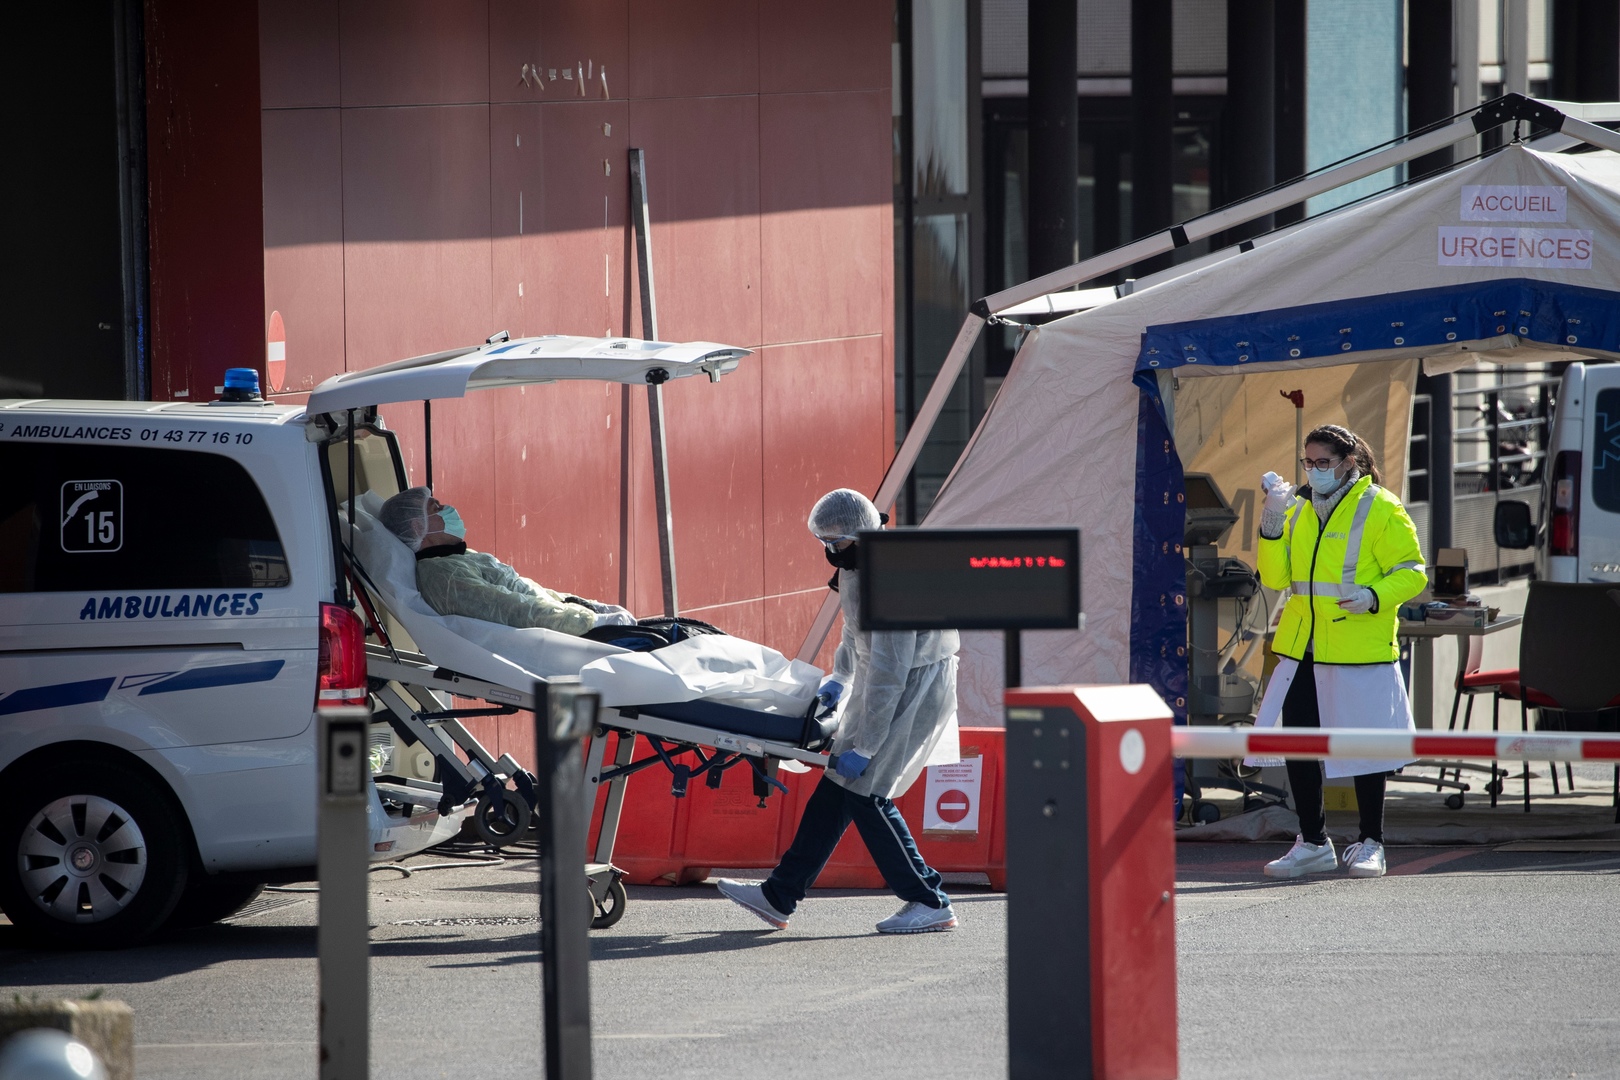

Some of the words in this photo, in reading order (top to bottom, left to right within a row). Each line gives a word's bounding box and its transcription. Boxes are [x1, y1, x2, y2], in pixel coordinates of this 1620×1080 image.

[1471, 195, 1557, 212] ACCUEIL
[1441, 236, 1591, 261] URGENCES
[11, 425, 132, 441] AMBULANCES
[140, 429, 158, 442] 01
[163, 430, 182, 442] 43
[188, 431, 207, 443] 77
[212, 432, 229, 444] 16
[235, 432, 253, 445] 10
[74, 483, 83, 491] EN
[83, 482, 111, 491] LIAISONS
[84, 511, 115, 544] 15
[79, 592, 263, 620] AMBULANCES
